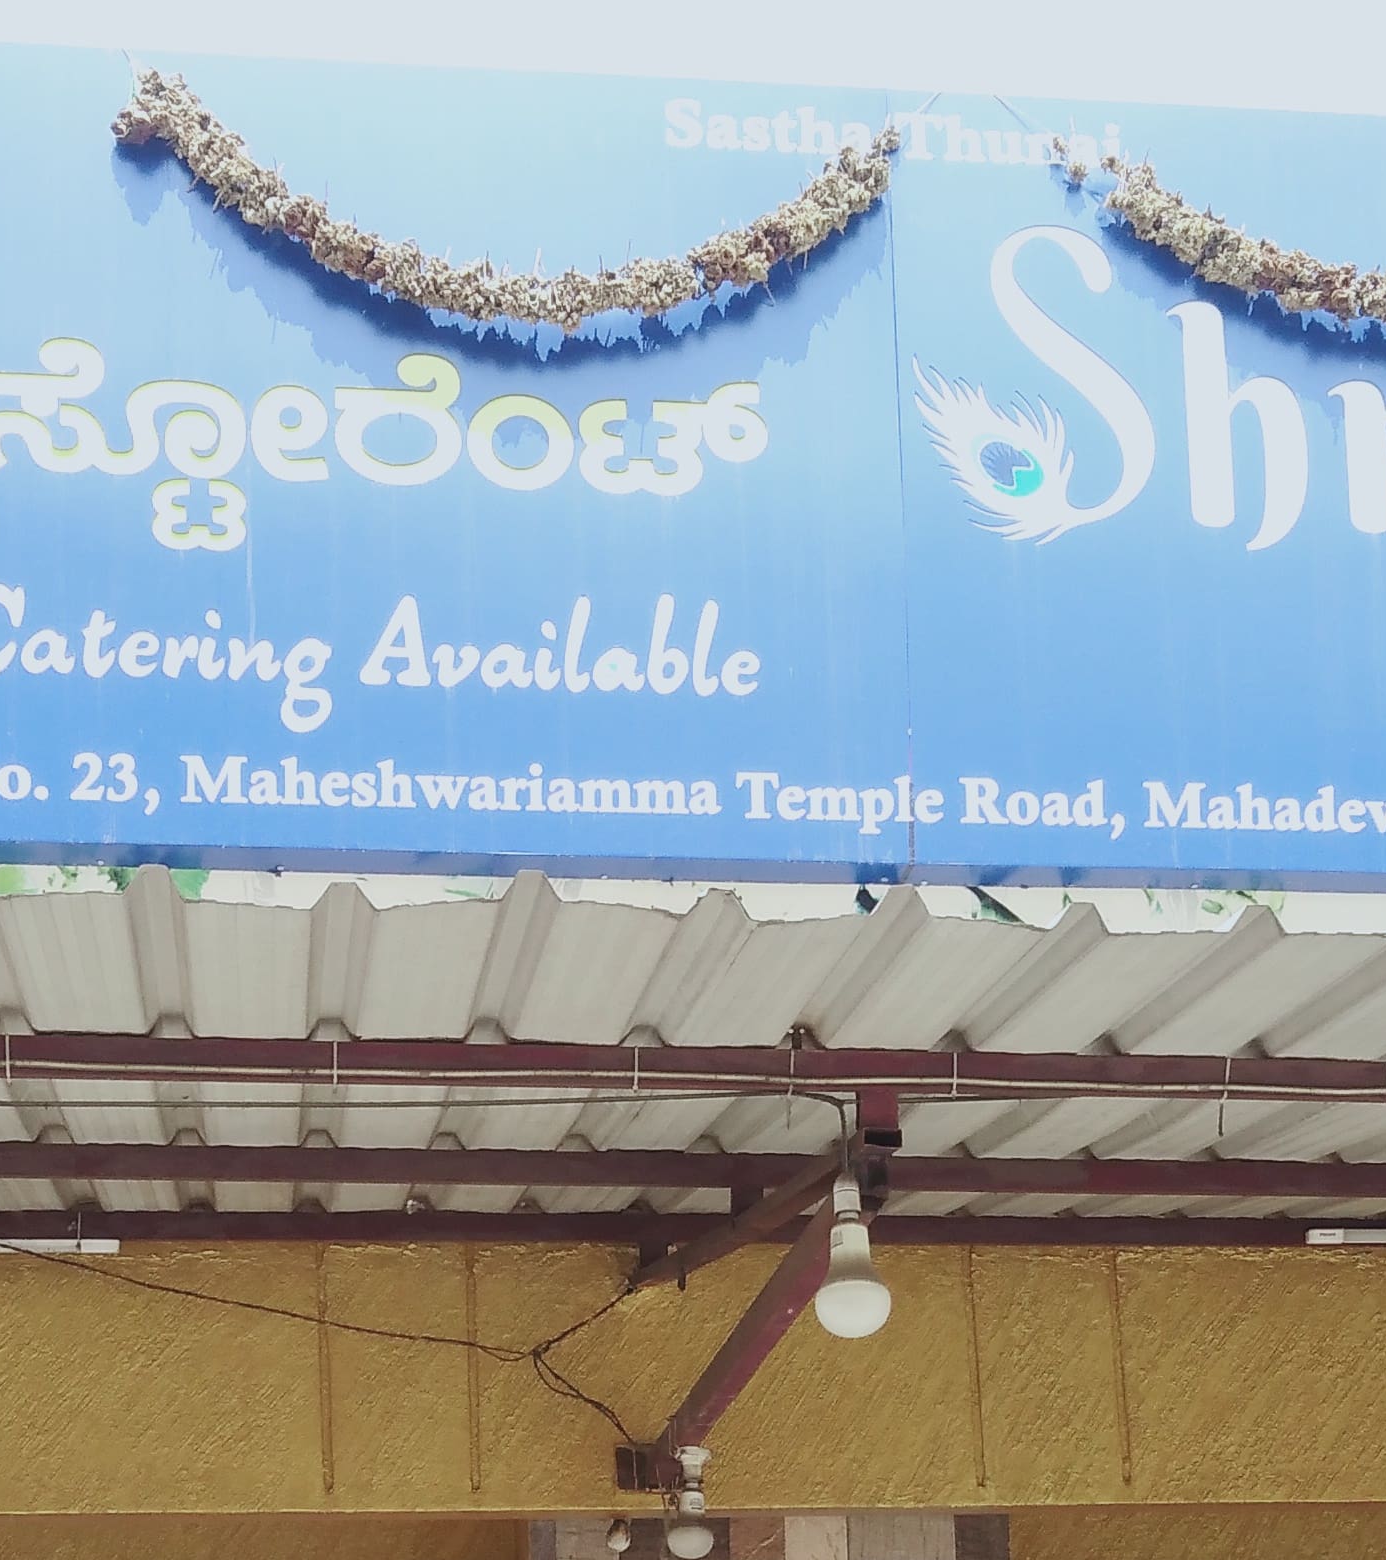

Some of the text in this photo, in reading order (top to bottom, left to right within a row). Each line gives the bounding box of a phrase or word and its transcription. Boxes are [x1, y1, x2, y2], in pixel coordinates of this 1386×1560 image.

[664, 97, 871, 155] Sastha
[360, 594, 761, 697] Available
[70, 752, 160, 816] 23,
[179, 754, 722, 817] Maheshwariamma
[736, 771, 945, 835] Temple
[959, 776, 1126, 840] Road,
